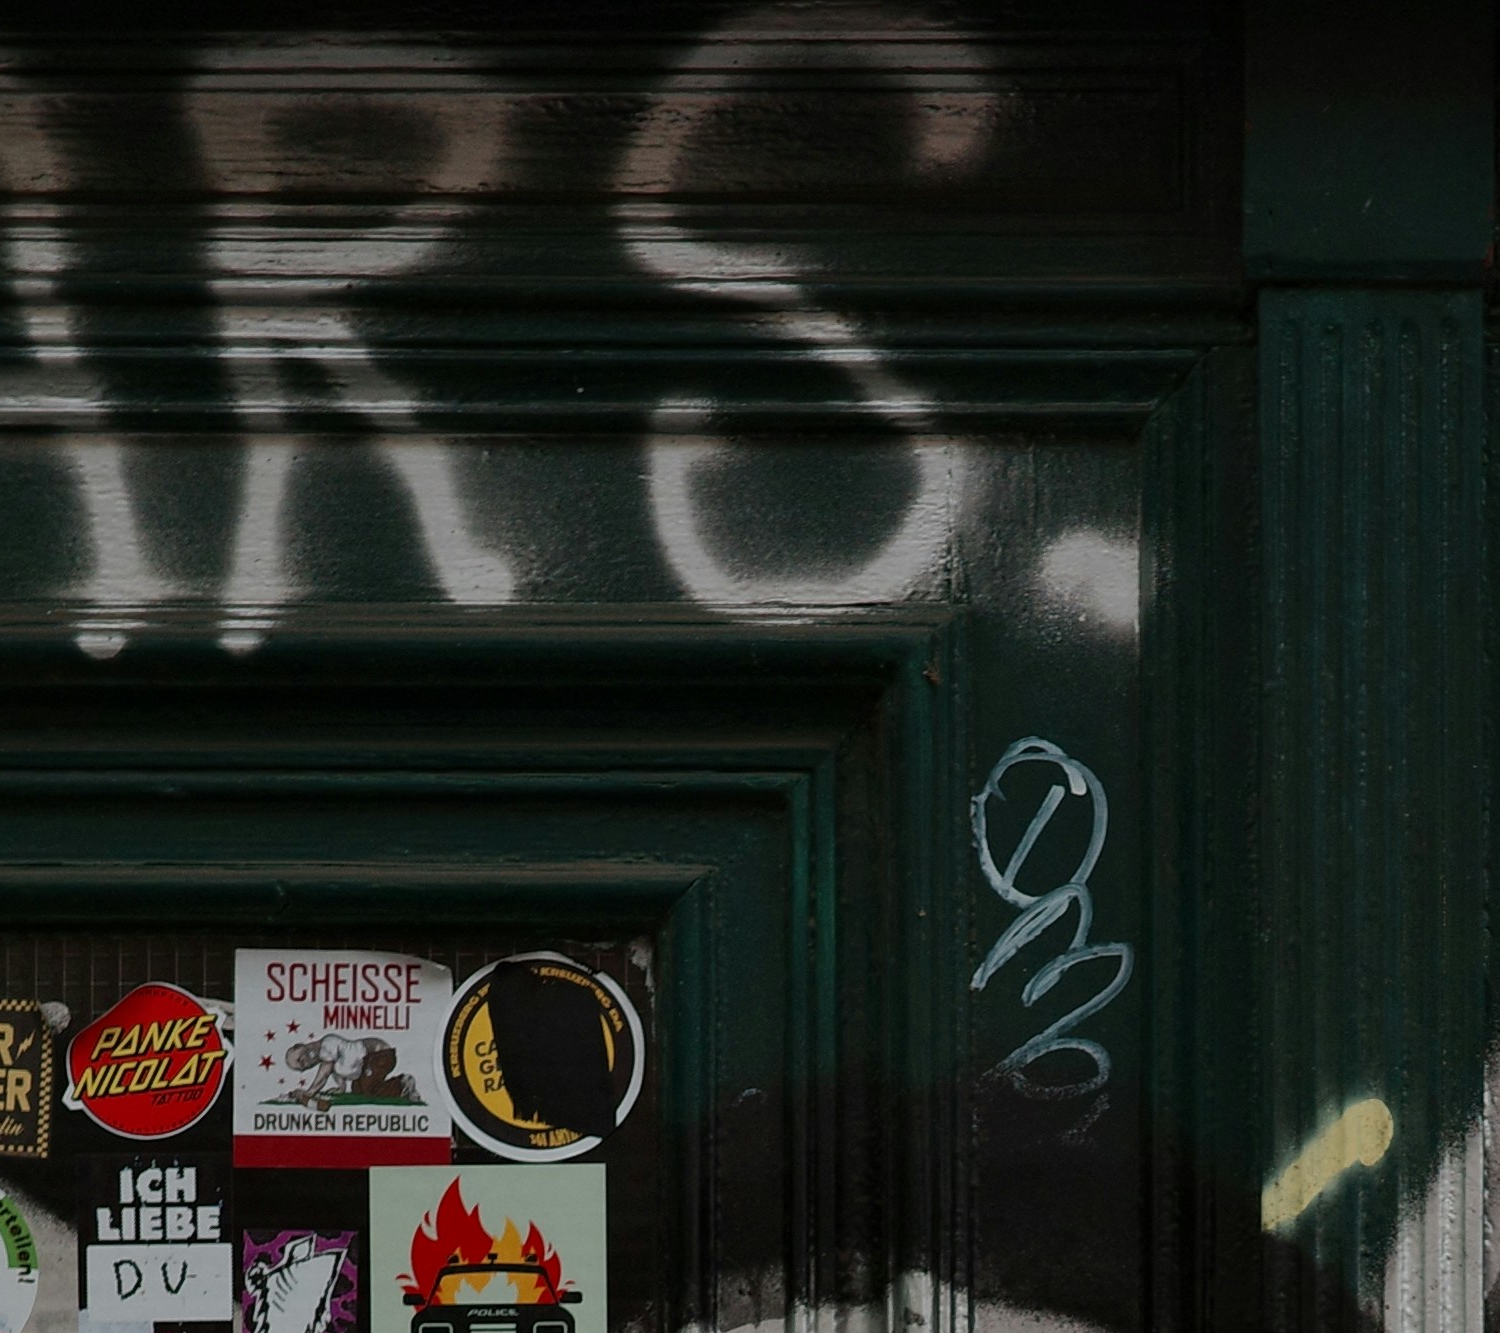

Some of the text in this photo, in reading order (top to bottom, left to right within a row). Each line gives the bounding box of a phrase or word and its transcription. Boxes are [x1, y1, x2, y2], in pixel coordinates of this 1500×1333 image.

[267, 963, 422, 1003] SCHEISSE
[94, 1014, 213, 1056] PANKE
[323, 1005, 411, 1031] MINNELLI
[73, 1049, 227, 1100] NICOLAT
[254, 1113, 430, 1132] DRUNKEN REPUBLIC
